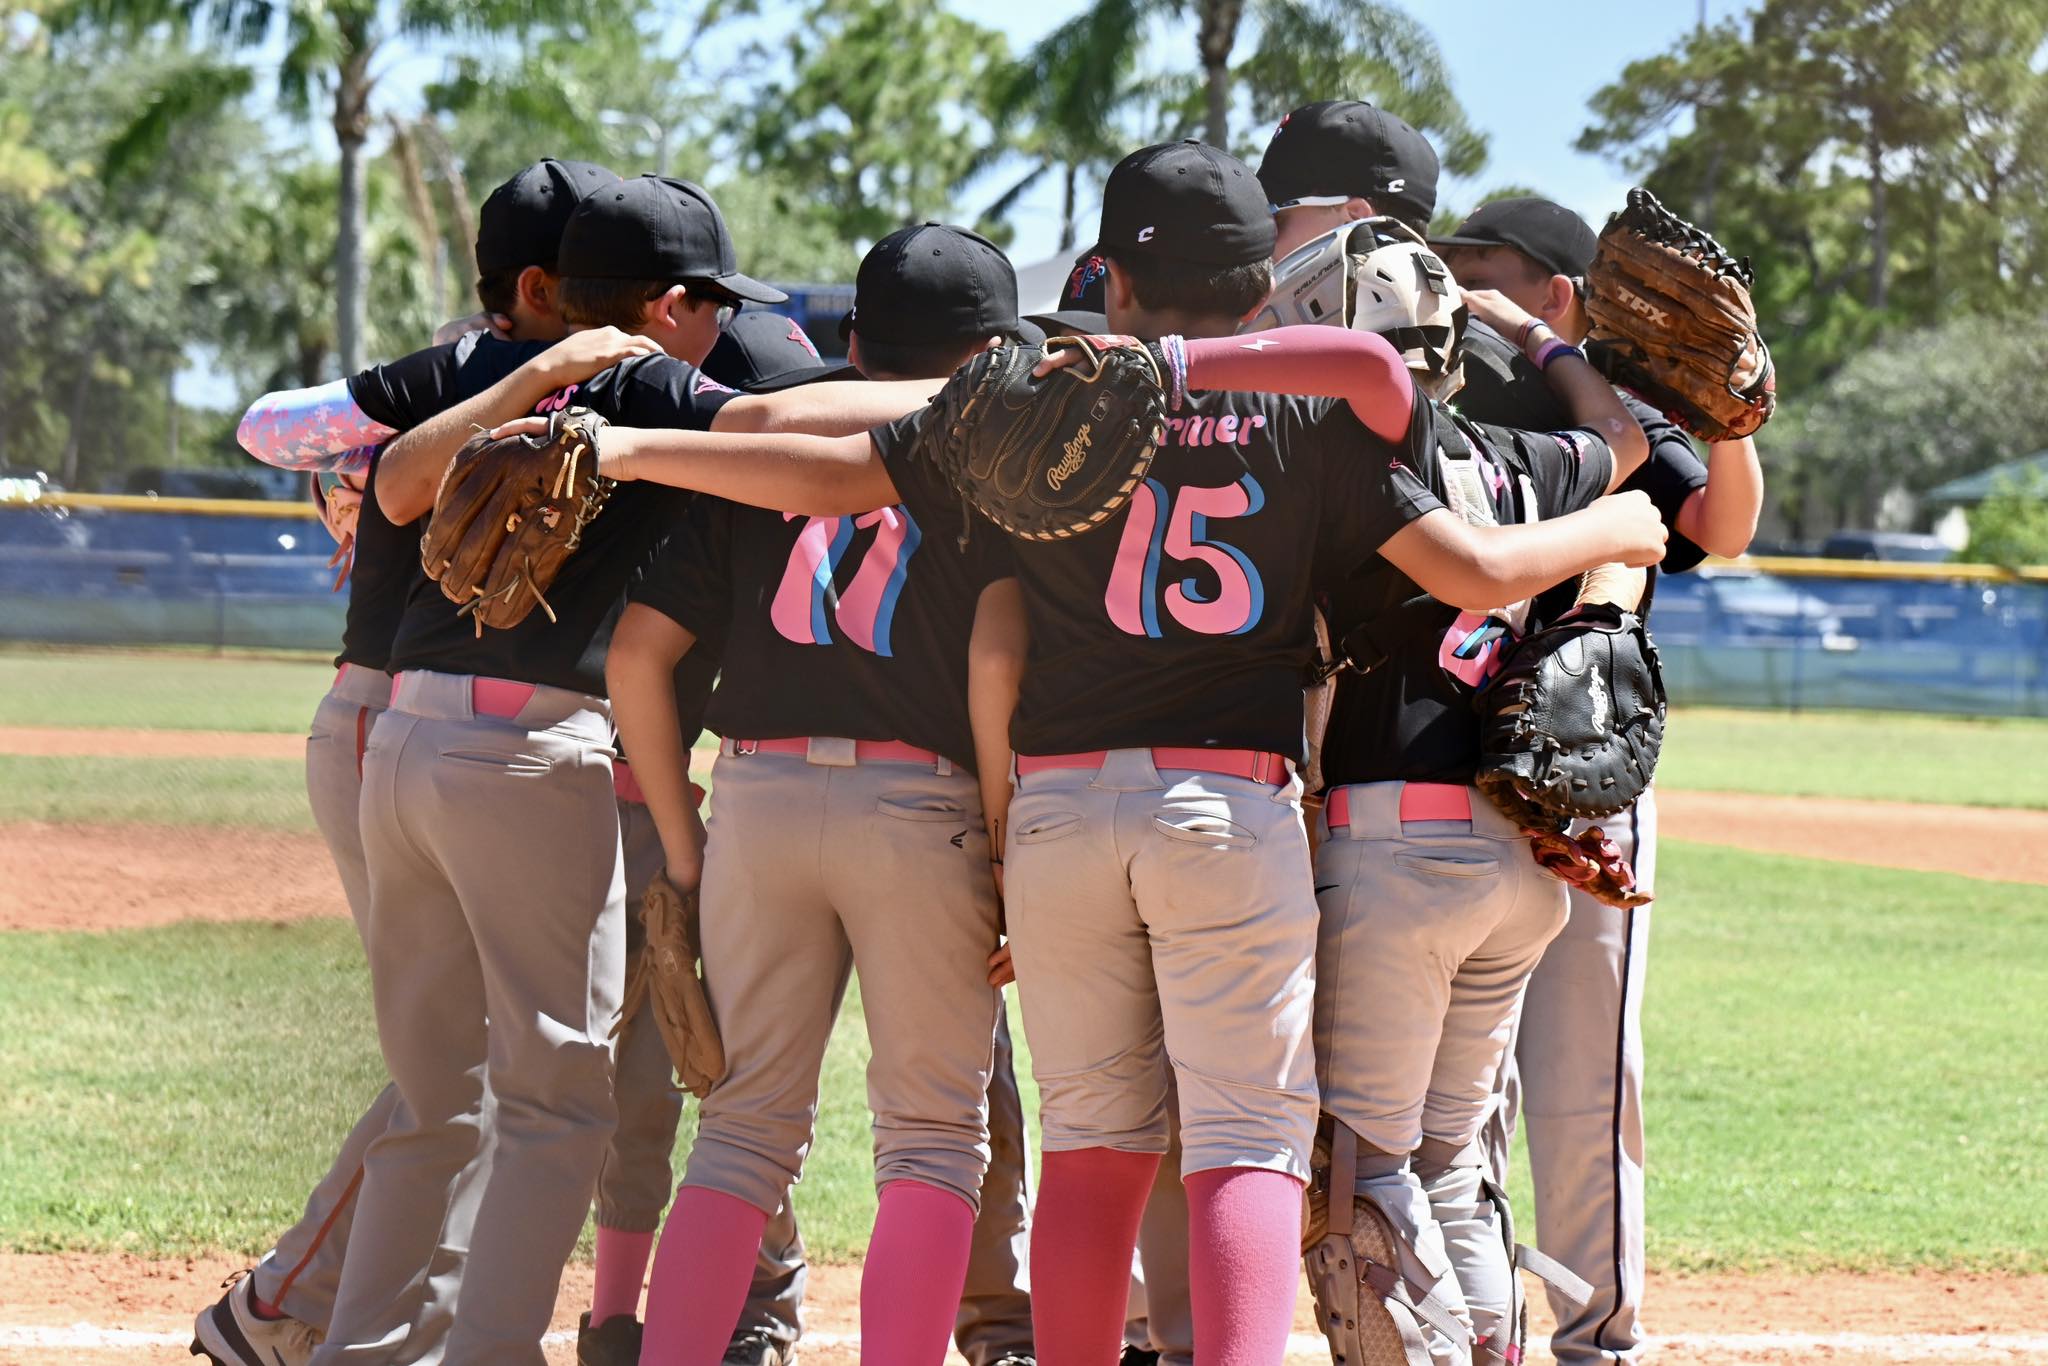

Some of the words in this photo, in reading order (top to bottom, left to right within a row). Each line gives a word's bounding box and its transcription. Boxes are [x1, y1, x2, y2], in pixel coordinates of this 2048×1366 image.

[1294, 256, 1341, 298] RAWLINGS
[1616, 285, 1670, 328] TPX
[1046, 422, 1092, 491] Rawlings
[1104, 471, 1265, 638] 15
